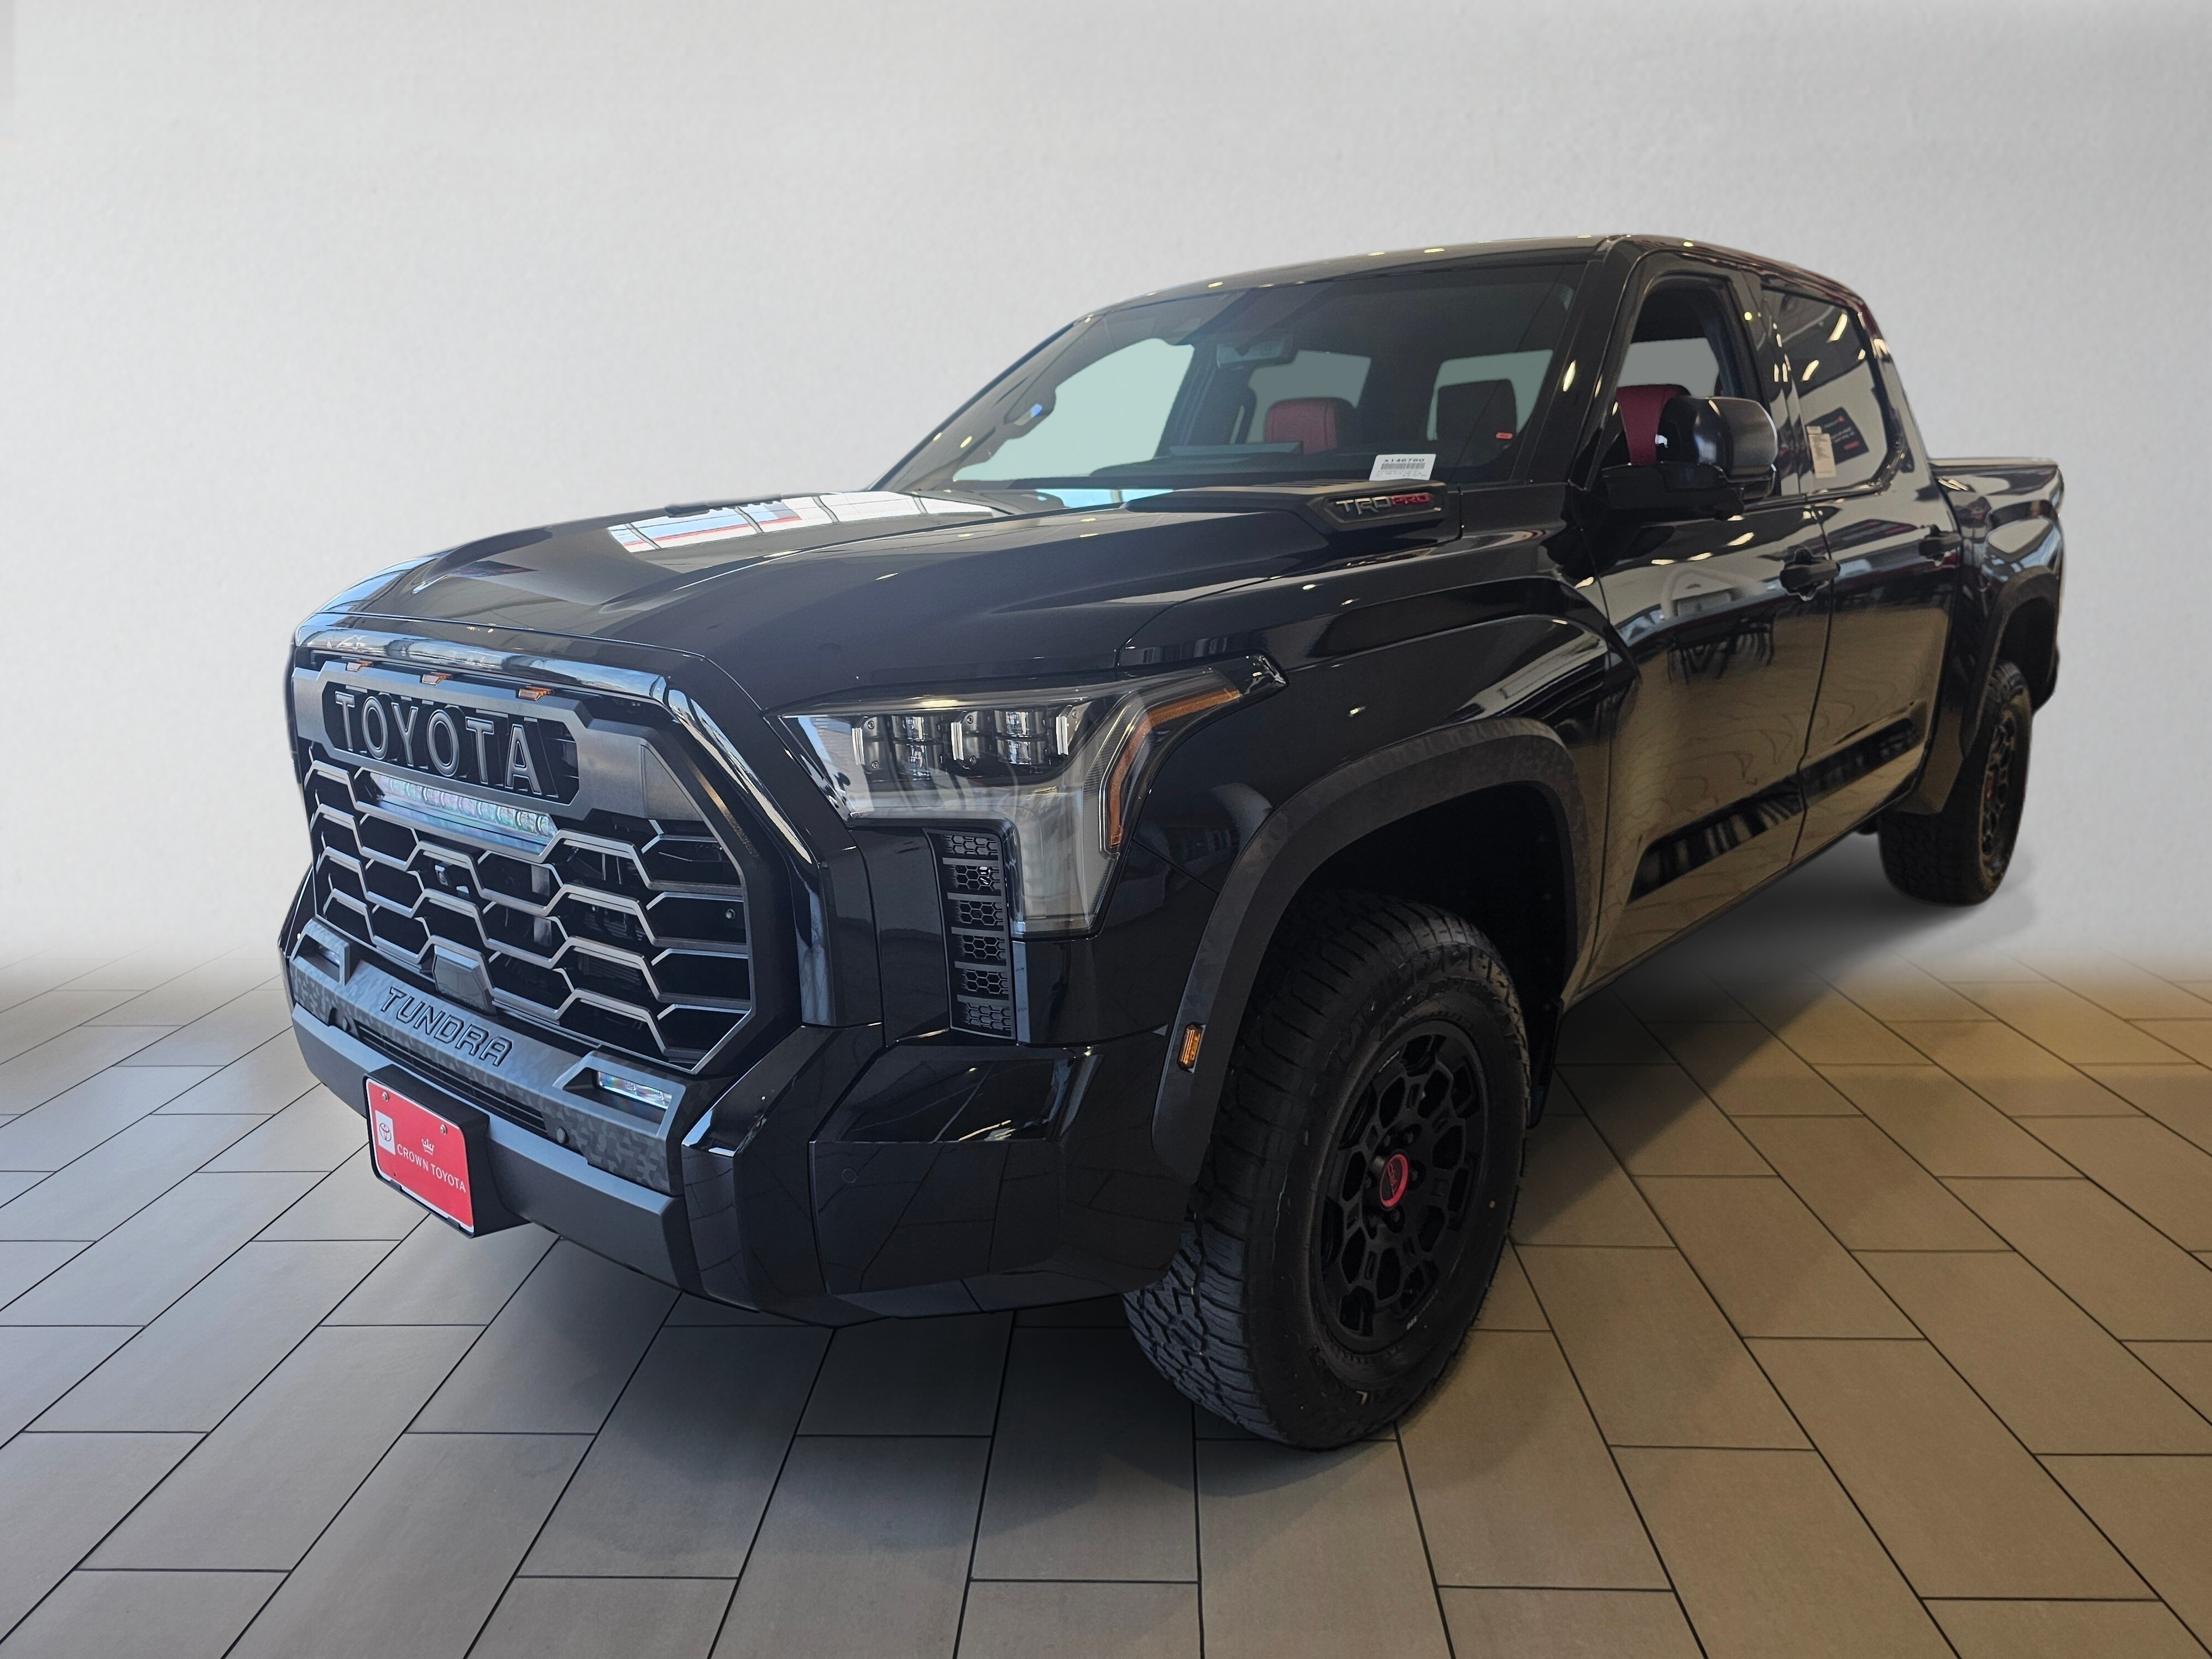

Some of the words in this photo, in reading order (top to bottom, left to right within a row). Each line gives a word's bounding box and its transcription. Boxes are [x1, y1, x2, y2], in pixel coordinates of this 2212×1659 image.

[1335, 496, 1392, 515] TRD
[1391, 493, 1431, 505] PRO
[335, 691, 542, 795] TOYOTA
[380, 986, 514, 1067] TUNDRA
[397, 1144, 429, 1172] CROWN
[430, 1163, 466, 1193] TOYOTA
